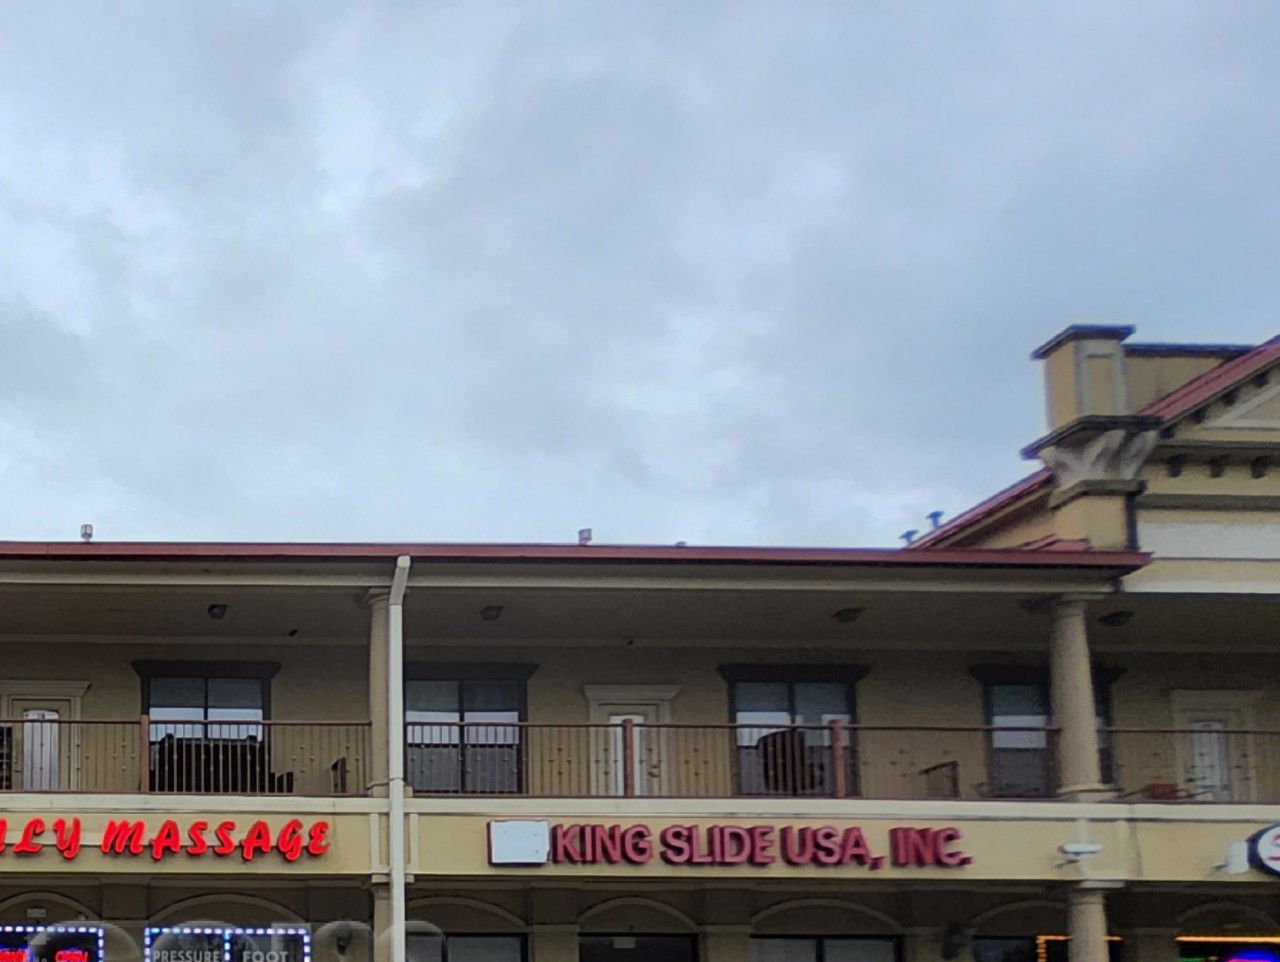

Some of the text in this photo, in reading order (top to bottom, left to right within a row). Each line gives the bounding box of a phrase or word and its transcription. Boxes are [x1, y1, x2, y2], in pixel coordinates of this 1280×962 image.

[99, 818, 331, 862] MASSAGE
[552, 824, 973, 871] KING SLIDE USA, INC.
